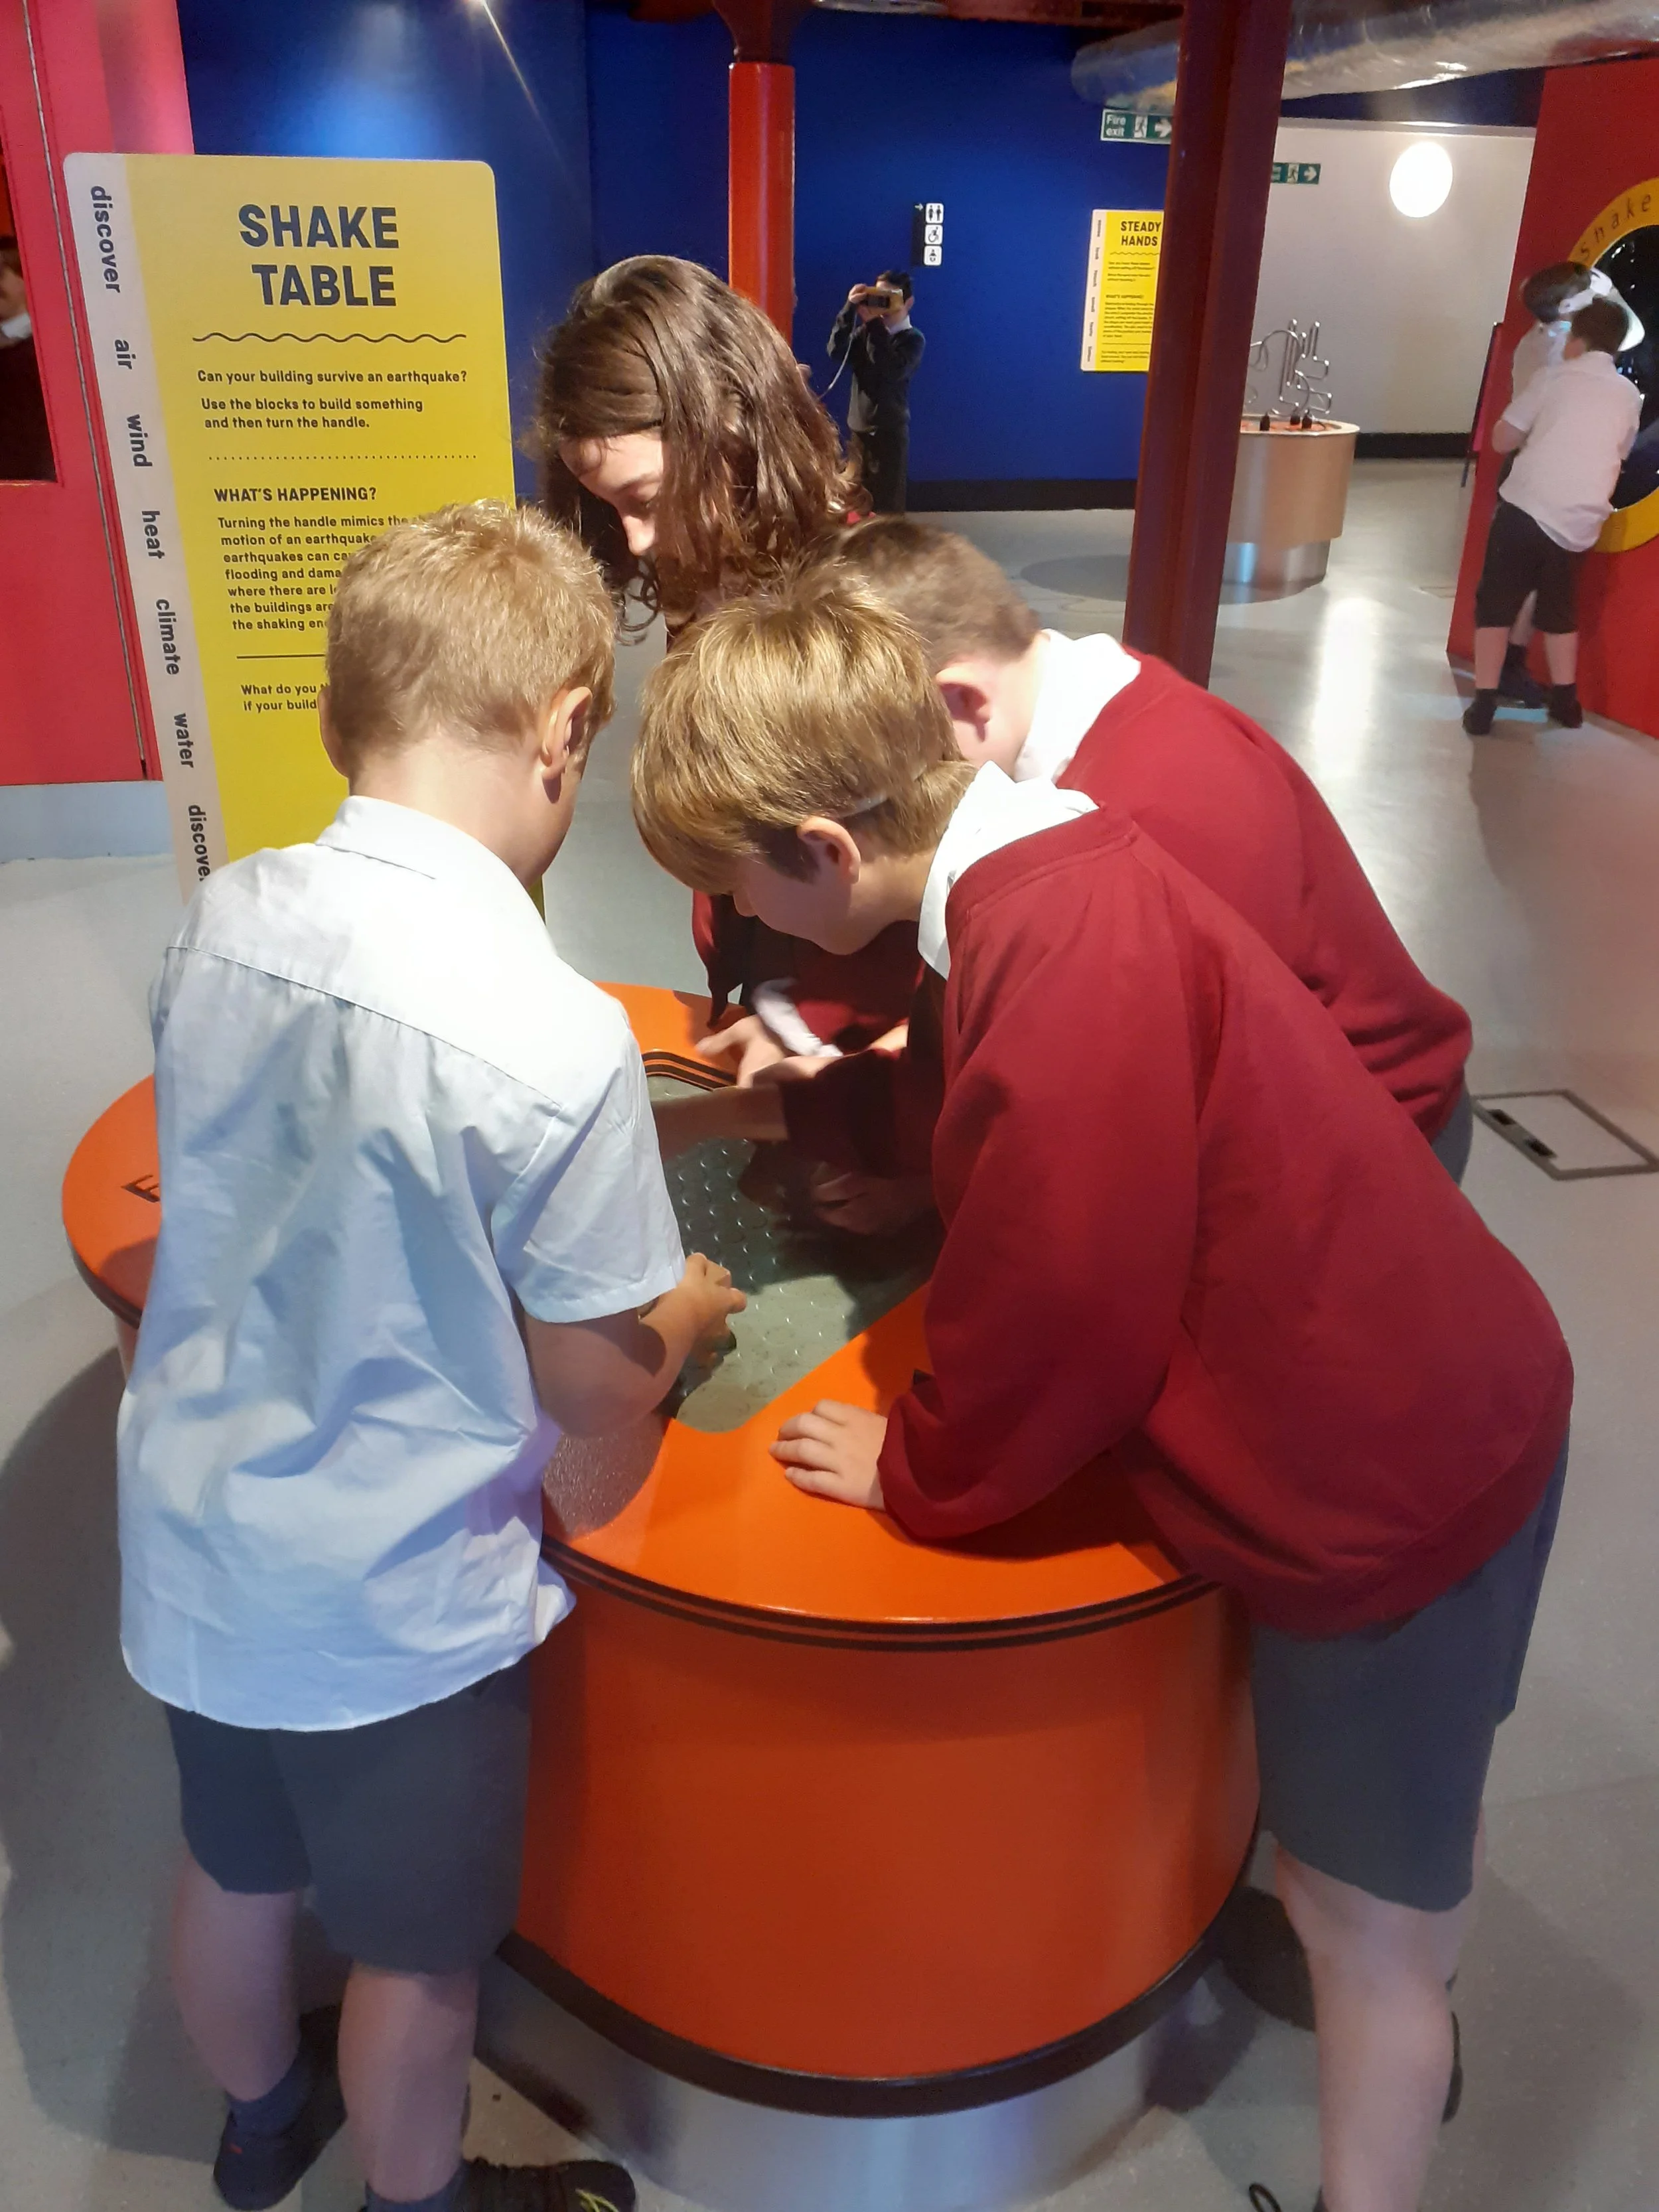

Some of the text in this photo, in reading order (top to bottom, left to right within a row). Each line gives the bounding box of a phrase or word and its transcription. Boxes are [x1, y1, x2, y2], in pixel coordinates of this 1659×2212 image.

[1106, 114, 1126, 125] Fire
[1106, 127, 1125, 136] exit
[238, 204, 399, 248] SHAKE
[1120, 221, 1161, 232] STEADY
[1121, 236, 1158, 246] HANDS
[252, 264, 397, 307] TABLE
[198, 370, 467, 385] Can your building survive an earthquake?
[201, 398, 423, 412] Use the blocks to build something
[204, 416, 370, 428] and then turn the handle.
[214, 487, 377, 502] WHAT'S HAPPENING?
[218, 516, 265, 530] Turning
[269, 516, 290, 528] the
[294, 516, 336, 527] handle
[340, 515, 384, 527] mimics
[91, 186, 211, 881] discover air wind heat climate water discove
[221, 534, 265, 546] motion
[269, 534, 283, 545] of
[287, 536, 301, 545] an
[223, 551, 303, 565] earthquakes
[307, 553, 330, 561] can
[225, 567, 342, 581] flooding and dama
[228, 585, 266, 596] where
[269, 585, 303, 596] there
[230, 603, 251, 613] the
[254, 602, 312, 615] buildings
[232, 619, 253, 630] the
[257, 619, 305, 630] shaking
[241, 684, 272, 696] What
[276, 684, 291, 694] do
[295, 686, 317, 696] you
[244, 699, 317, 713] if your build
